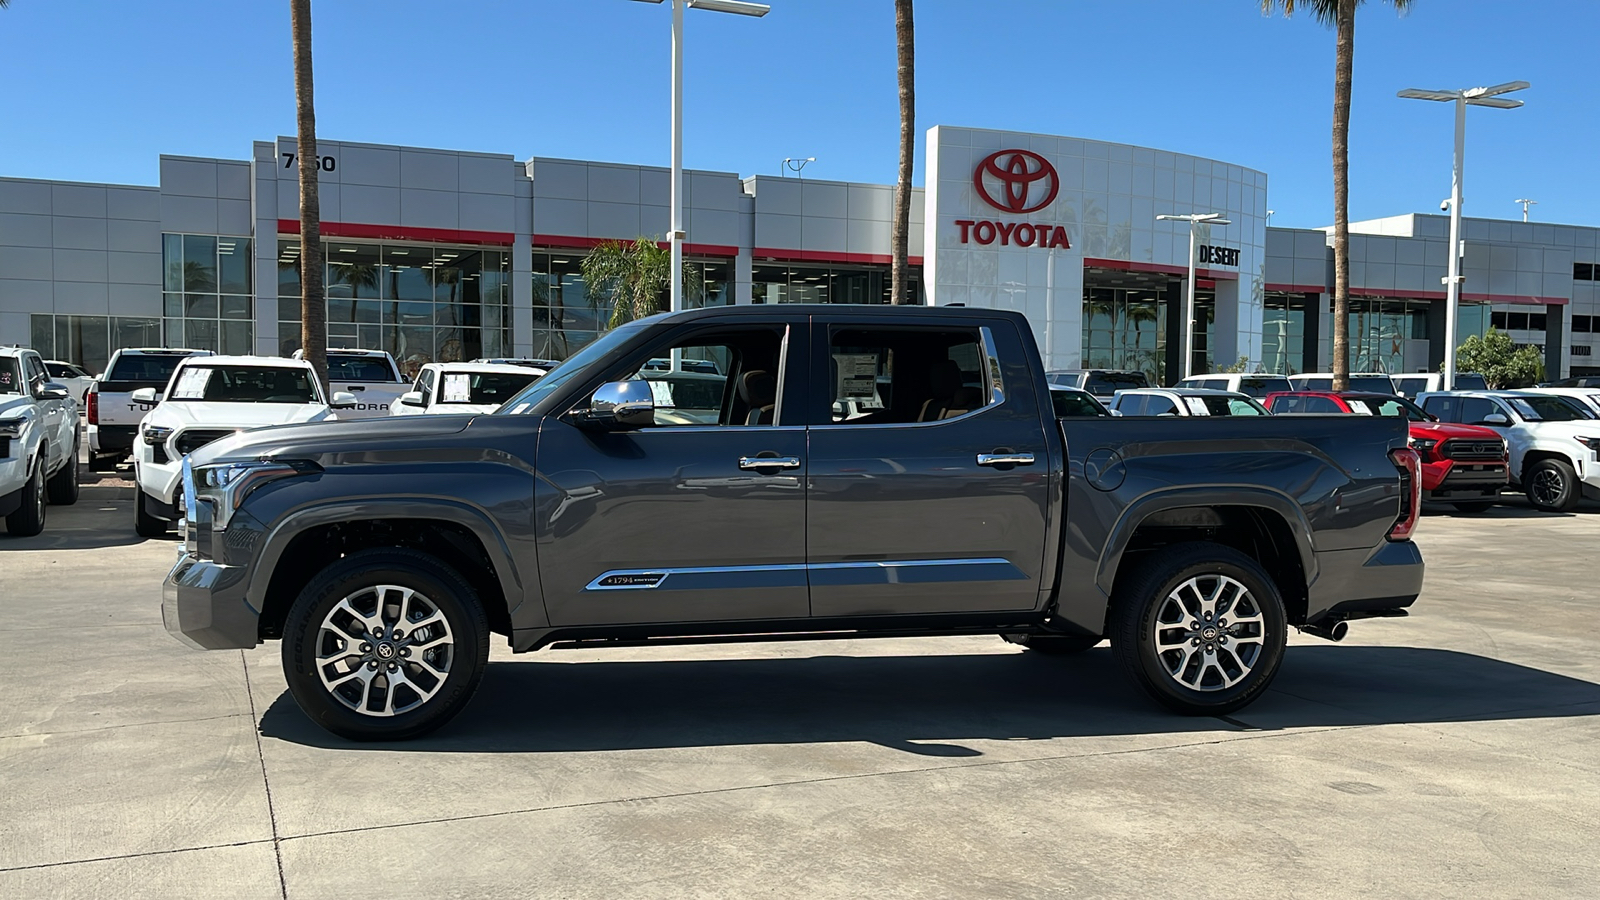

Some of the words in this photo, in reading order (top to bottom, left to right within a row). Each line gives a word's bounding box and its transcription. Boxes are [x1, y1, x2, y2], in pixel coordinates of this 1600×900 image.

[282, 152, 336, 172] 70
[954, 219, 1071, 250] TOYOTA
[1199, 244, 1241, 267] DESERT
[294, 583, 335, 674] GEOLANDAR
